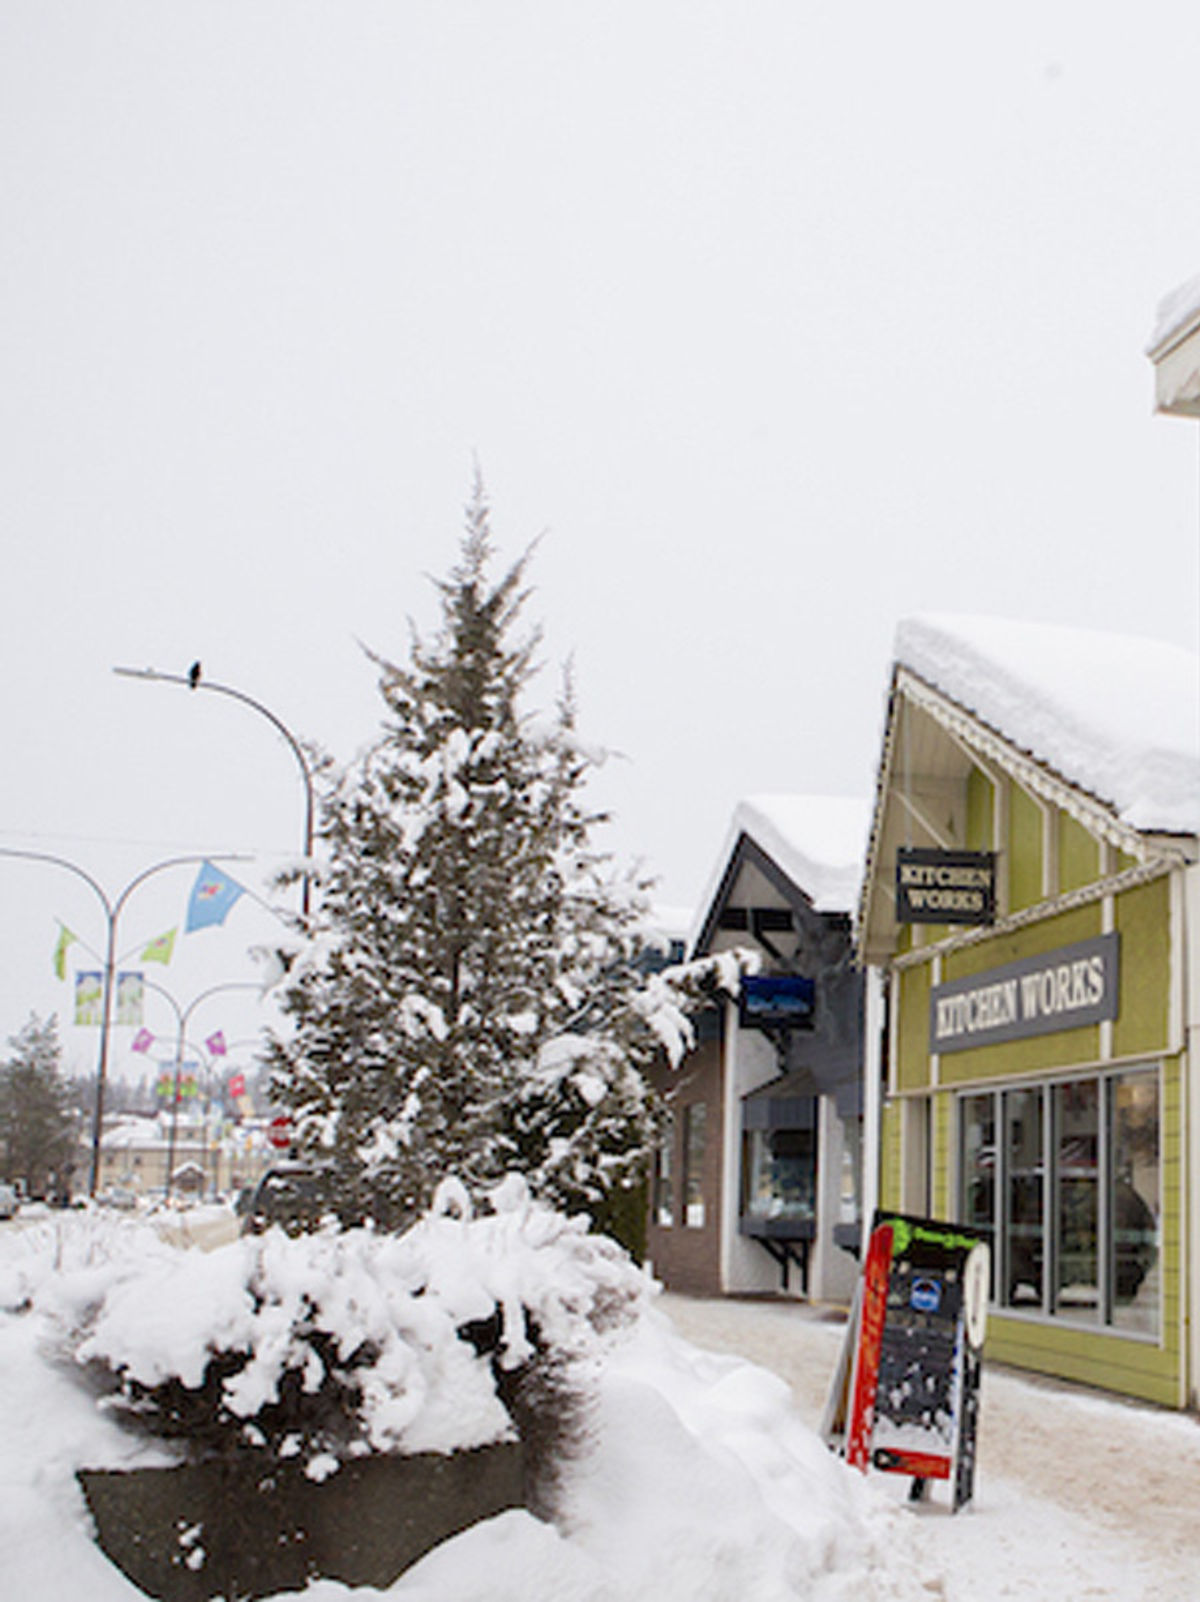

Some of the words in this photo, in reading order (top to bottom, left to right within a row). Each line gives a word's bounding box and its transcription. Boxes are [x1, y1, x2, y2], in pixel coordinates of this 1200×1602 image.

[901, 864, 992, 888] KITCHEN
[907, 889, 984, 912] WORKS
[936, 978, 1018, 1039] KITCHEN
[1020, 956, 1105, 1020] WORKS
